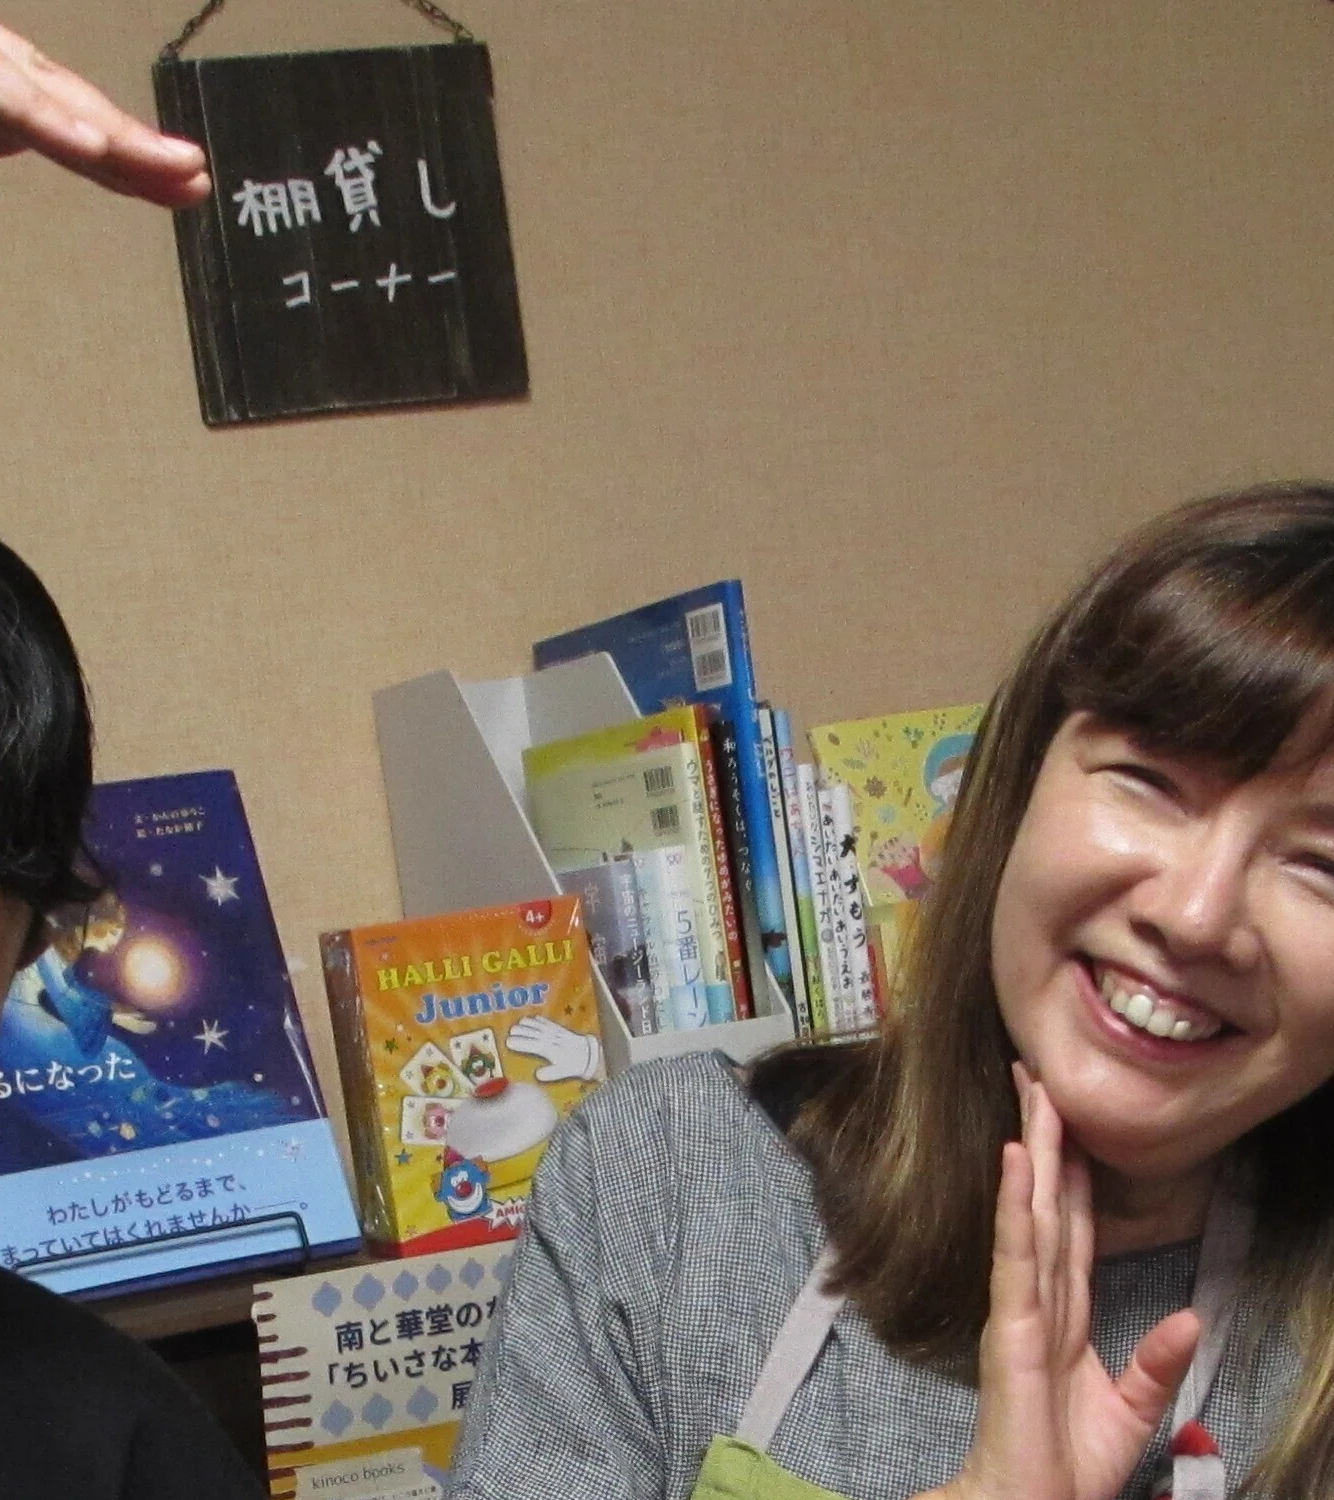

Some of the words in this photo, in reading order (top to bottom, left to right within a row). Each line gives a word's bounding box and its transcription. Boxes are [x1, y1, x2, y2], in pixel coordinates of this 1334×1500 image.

[233, 139, 457, 238] 棚貸し
[281, 262, 457, 309] コーナー
[525, 909, 545, 924] 4+
[376, 955, 473, 993] HALLI
[481, 937, 577, 975] GALLI
[414, 981, 550, 1025] Junior
[46, 1173, 248, 1227] わたしがもどるまで、
[311, 1471, 359, 1490] kinoco
[362, 1461, 406, 1481] books
